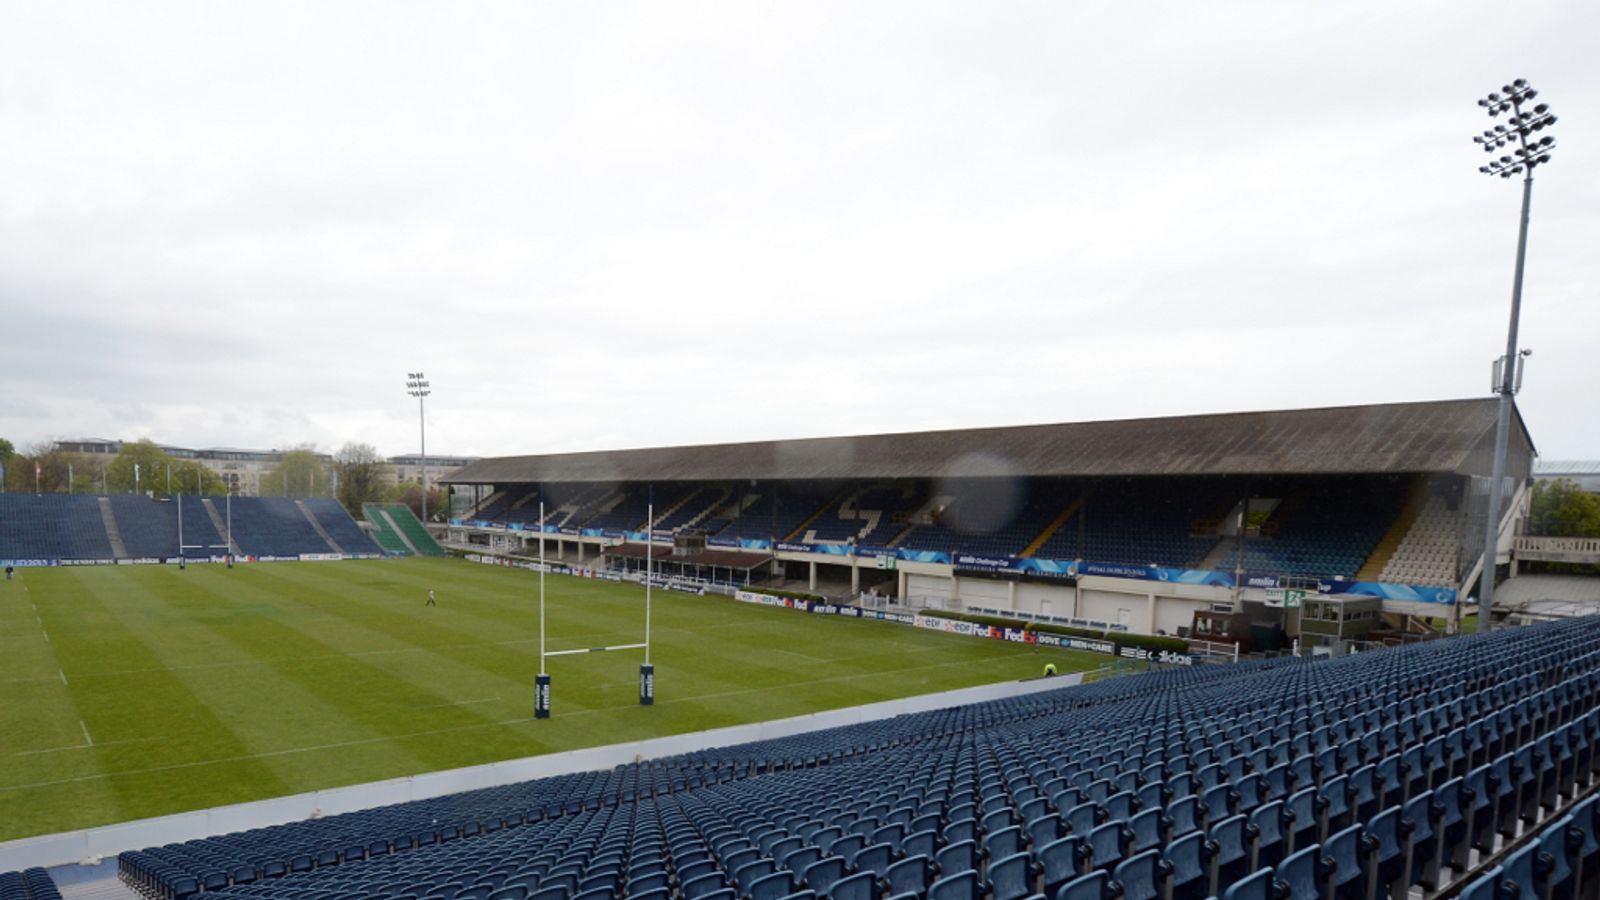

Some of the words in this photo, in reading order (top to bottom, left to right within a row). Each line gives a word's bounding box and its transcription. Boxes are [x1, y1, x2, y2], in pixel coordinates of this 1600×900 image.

[974, 624, 1003, 640] FedEx
[1005, 628, 1037, 645] FedEx
[1039, 635, 1060, 645] DOVE
